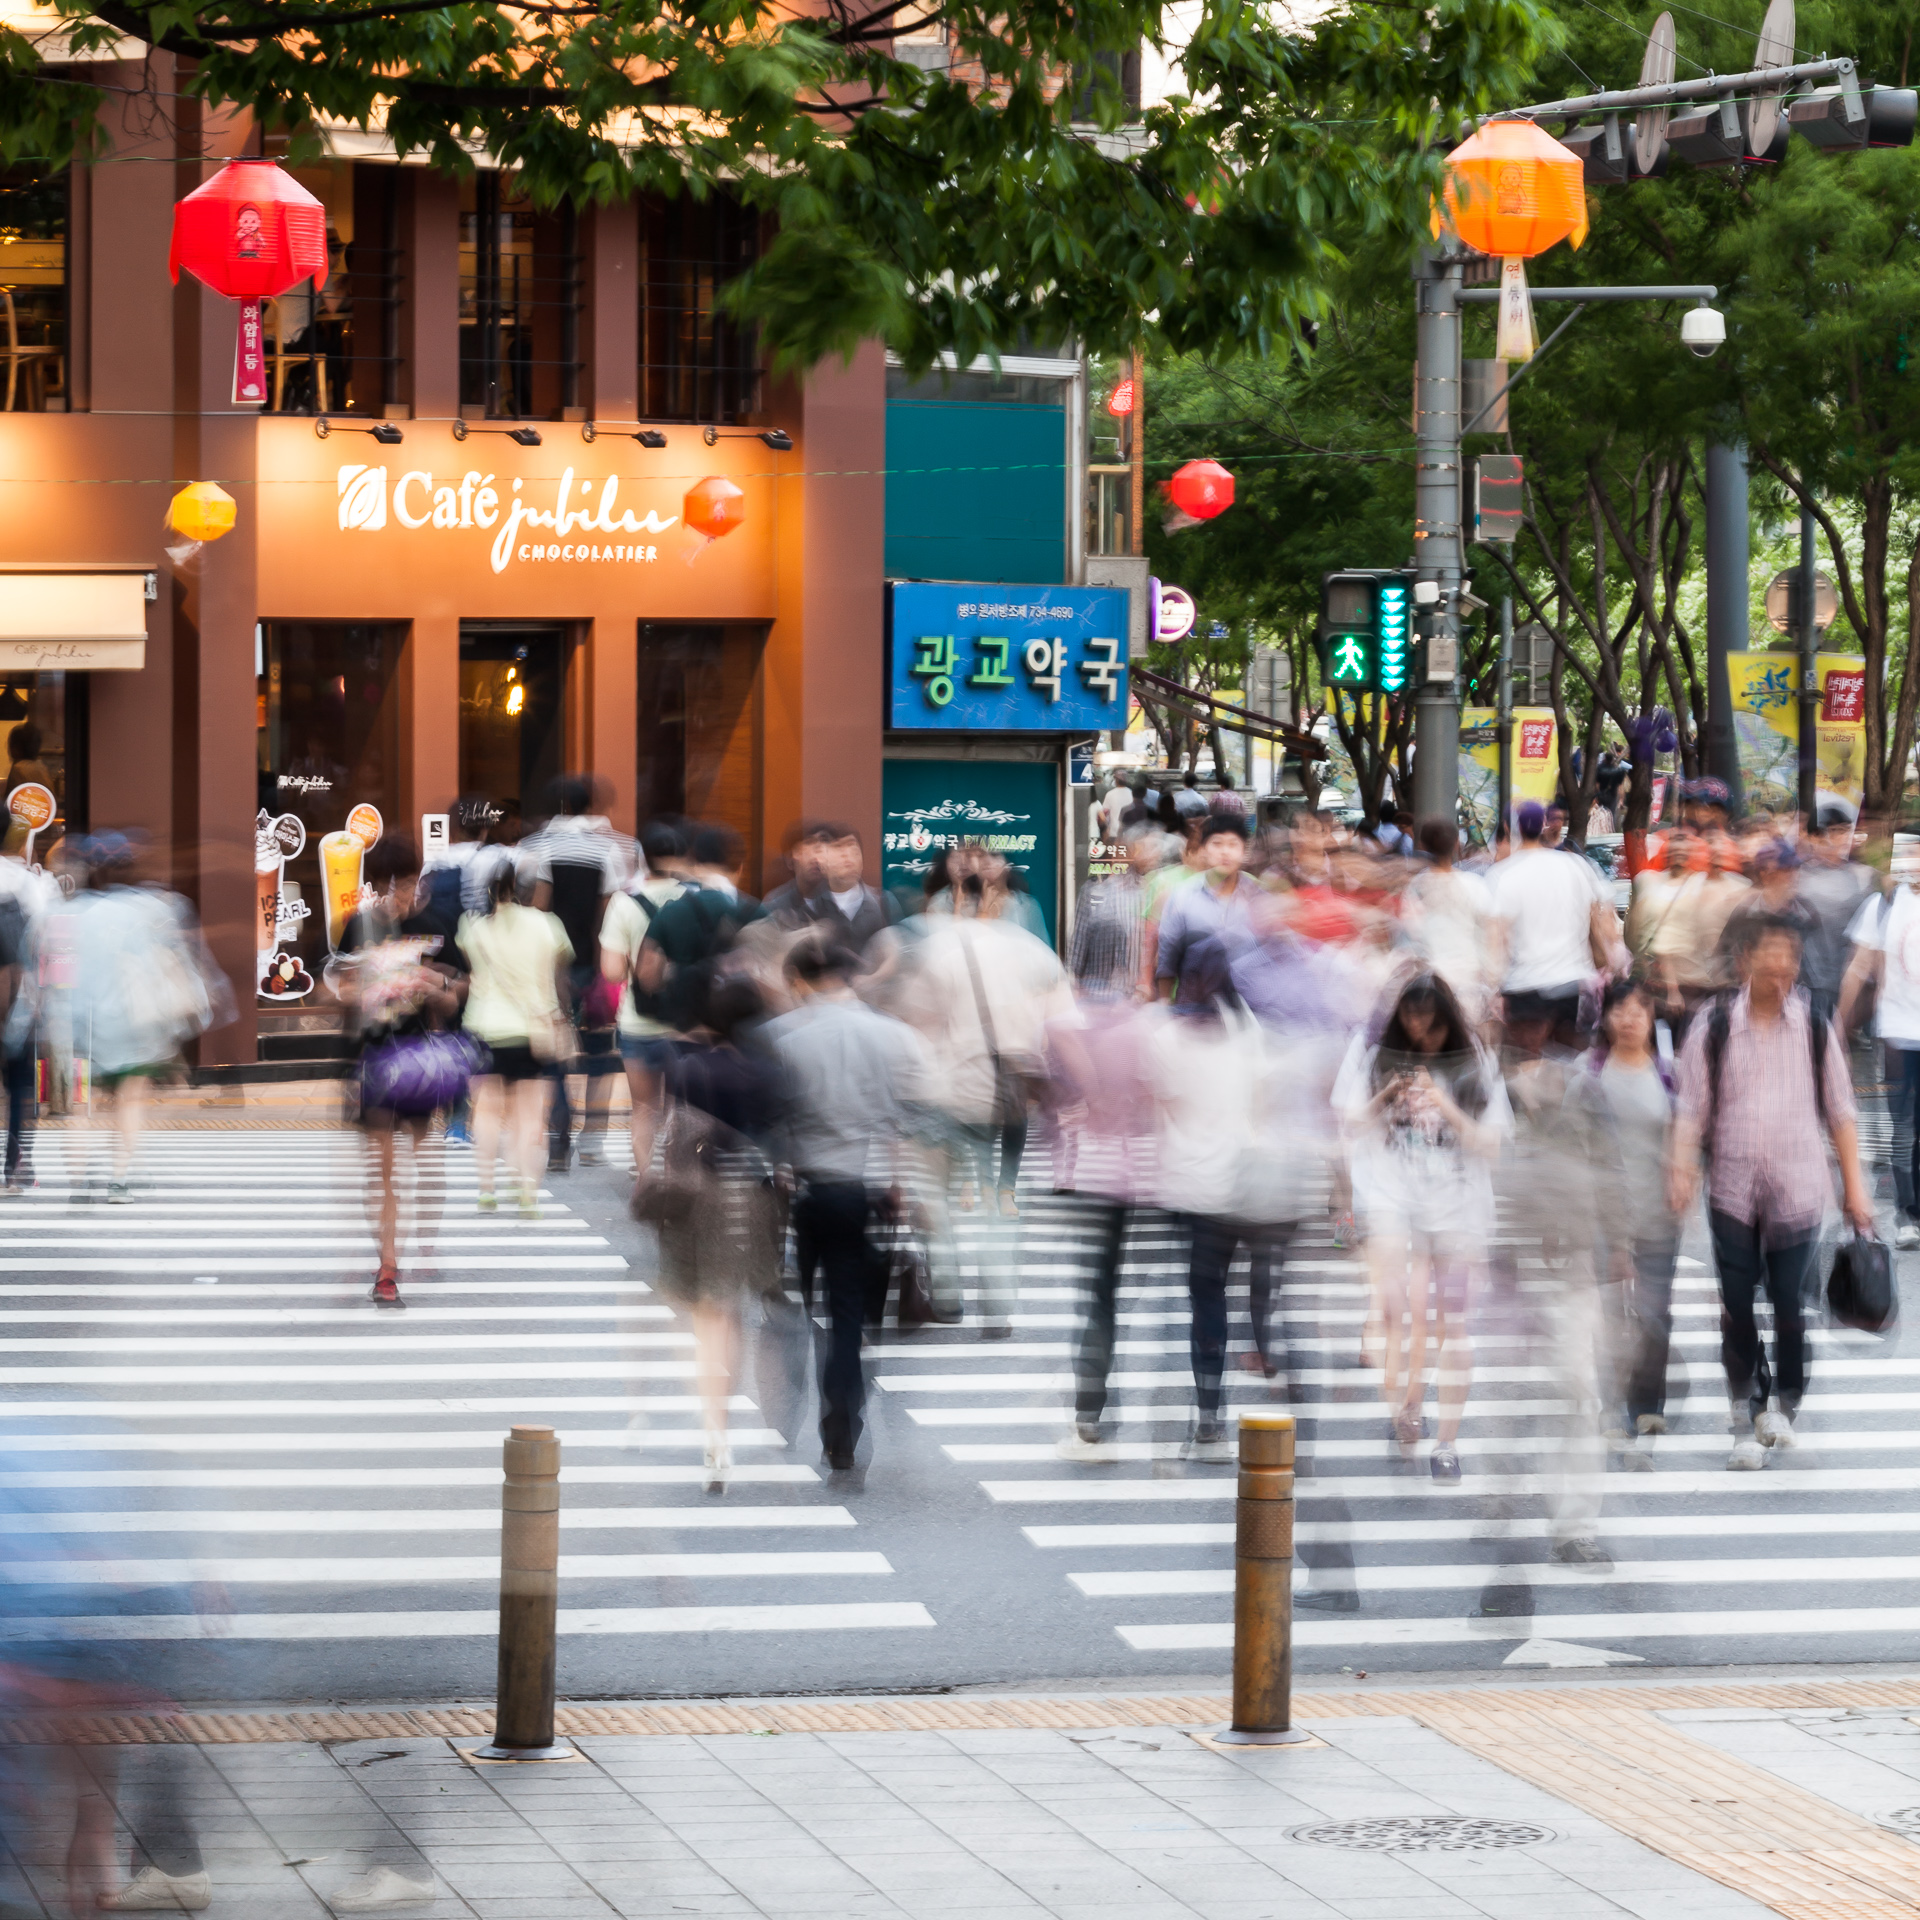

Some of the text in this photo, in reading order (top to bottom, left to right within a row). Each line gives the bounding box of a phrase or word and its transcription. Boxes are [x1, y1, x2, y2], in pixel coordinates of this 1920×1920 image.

[243, 305, 259, 370] 화합의 등
[393, 470, 500, 530] Café
[517, 543, 658, 562] CHOCOLATIER
[1028, 605, 1074, 619] 734-4690
[909, 634, 1125, 707] 광교약국
[884, 833, 909, 851] 광교
[933, 834, 959, 850] 약국
[264, 901, 309, 927] PEARL
